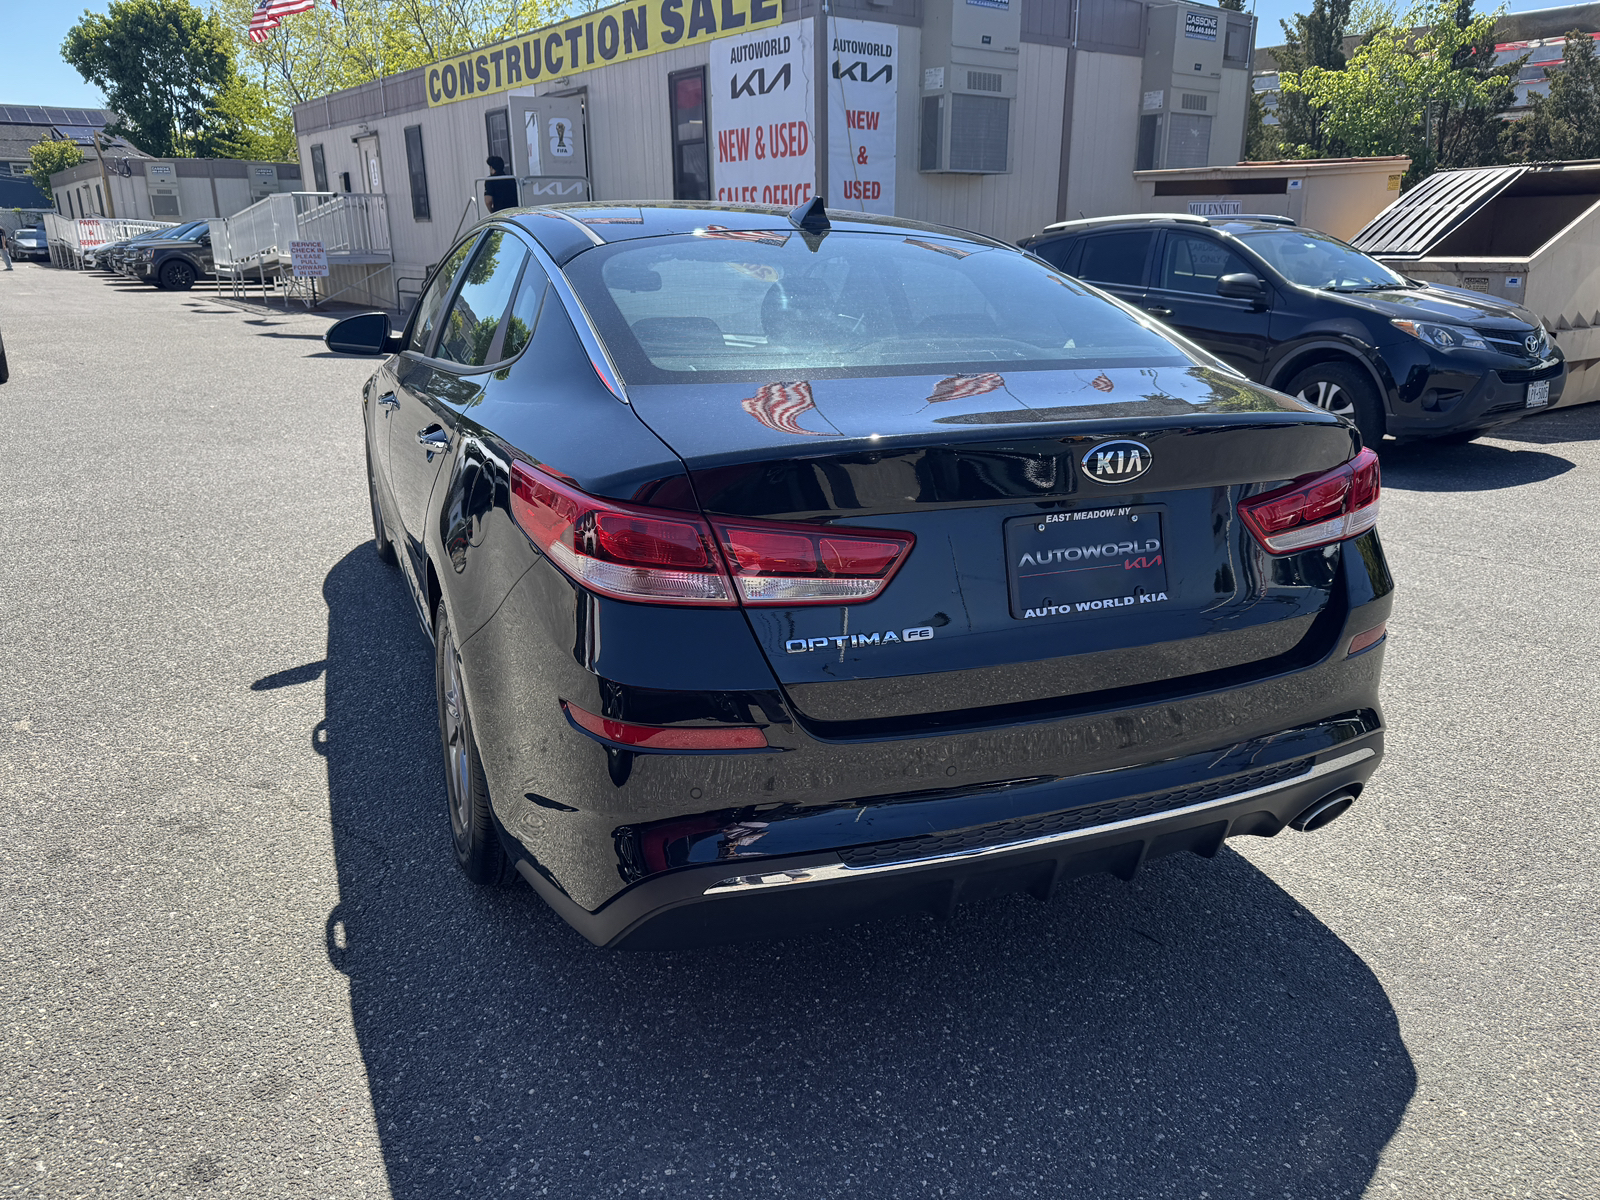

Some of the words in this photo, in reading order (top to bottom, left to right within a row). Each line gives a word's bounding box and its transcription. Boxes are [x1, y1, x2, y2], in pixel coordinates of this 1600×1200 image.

[1187, 15, 1217, 28] CASSONE
[428, 5, 649, 103] CONSTRUCTION
[730, 36, 791, 64] AUTOWORLD
[833, 38, 892, 57] AUTOWORLD
[731, 63, 791, 99] KIA
[832, 59, 892, 84] KIA
[846, 110, 880, 130] NEW
[718, 127, 750, 163] NEW
[755, 125, 766, 161] &
[769, 121, 809, 159] USED
[857, 146, 868, 165] &
[718, 186, 758, 204] SALES
[763, 182, 811, 206] OFFICE
[843, 180, 881, 199] USED
[1189, 204, 1240, 215] MILLENNIUM
[1096, 450, 1142, 474] KIA
[1046, 513, 1071, 523] EAST
[1118, 507, 1132, 516] NY
[1018, 538, 1161, 568] AUTOWORLD
[1124, 555, 1162, 570] KIA
[1024, 604, 1071, 619] AUTO
[1076, 596, 1135, 612] WORLD
[1139, 592, 1168, 604] KIA
[785, 630, 901, 654] OPTIMA
